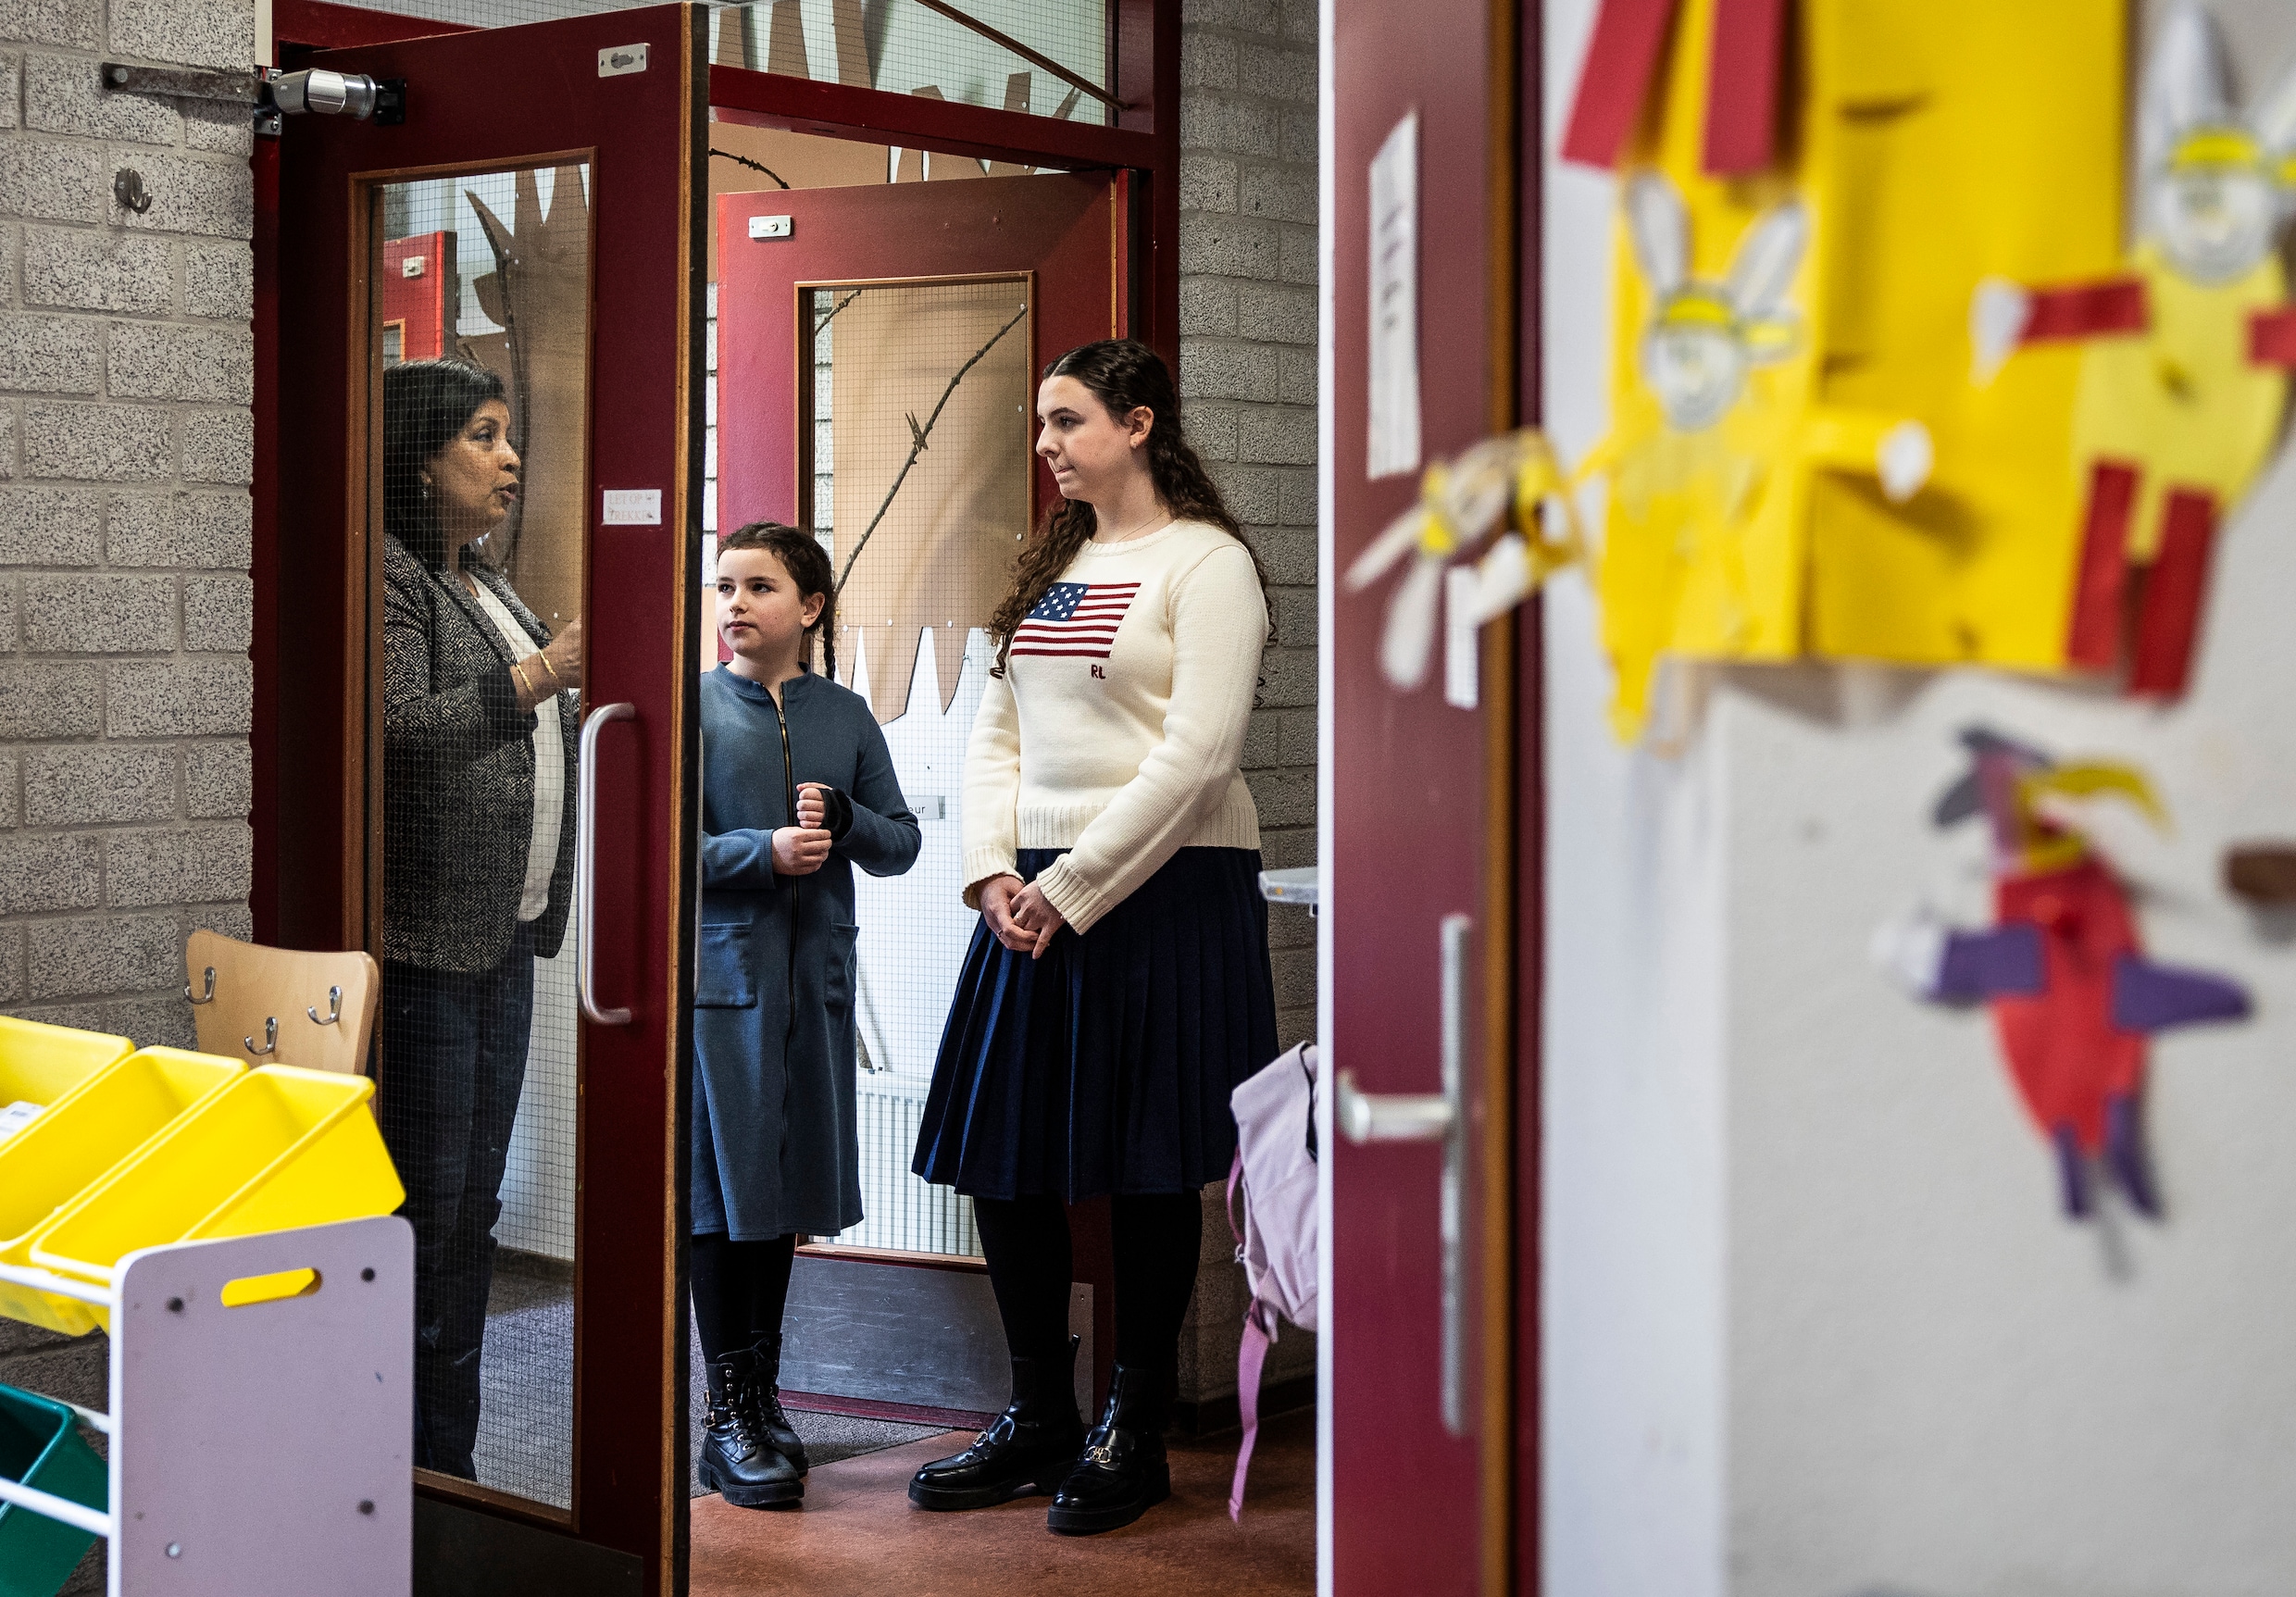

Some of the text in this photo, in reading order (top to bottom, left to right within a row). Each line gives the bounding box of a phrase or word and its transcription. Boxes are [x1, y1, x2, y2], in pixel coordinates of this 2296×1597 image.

[609, 493, 627, 505] LET
[630, 493, 643, 505] OP
[1091, 664, 1106, 680] RL
